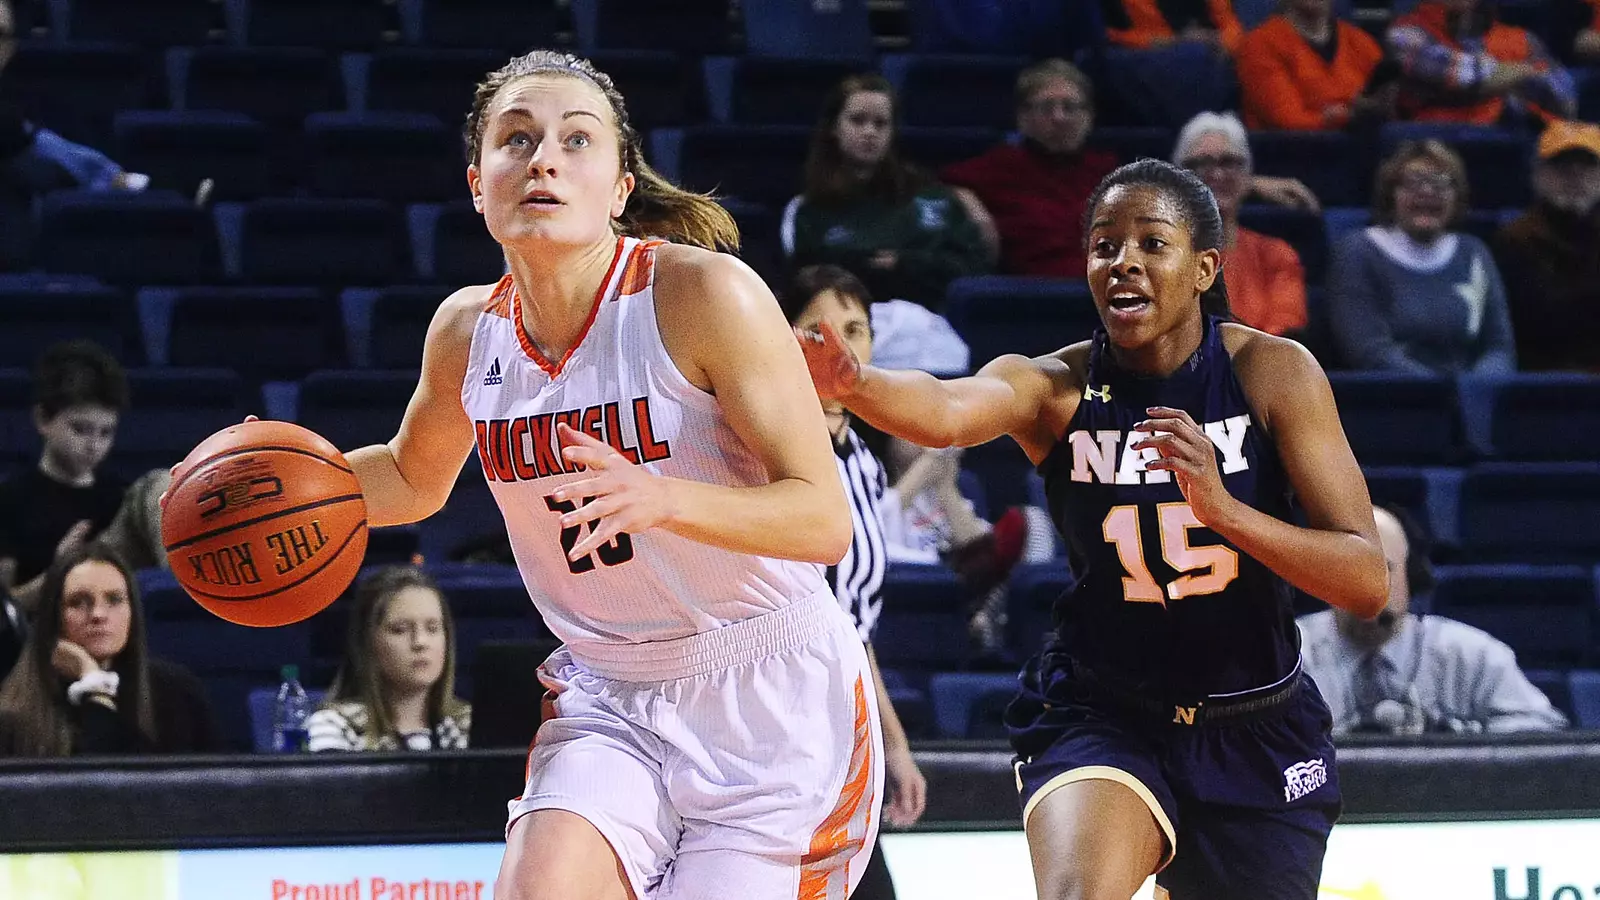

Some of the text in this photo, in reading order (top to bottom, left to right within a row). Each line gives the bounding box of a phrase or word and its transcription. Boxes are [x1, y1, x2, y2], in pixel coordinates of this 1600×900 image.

[484, 374, 502, 386] adidas
[1069, 414, 1251, 485] NAY
[188, 520, 330, 585] THE ROCK
[1102, 502, 1239, 604] 15
[1173, 705, 1197, 725] N
[1286, 776, 1328, 802] LEAGUE
[272, 878, 360, 900] Proud
[370, 877, 486, 900] Partner
